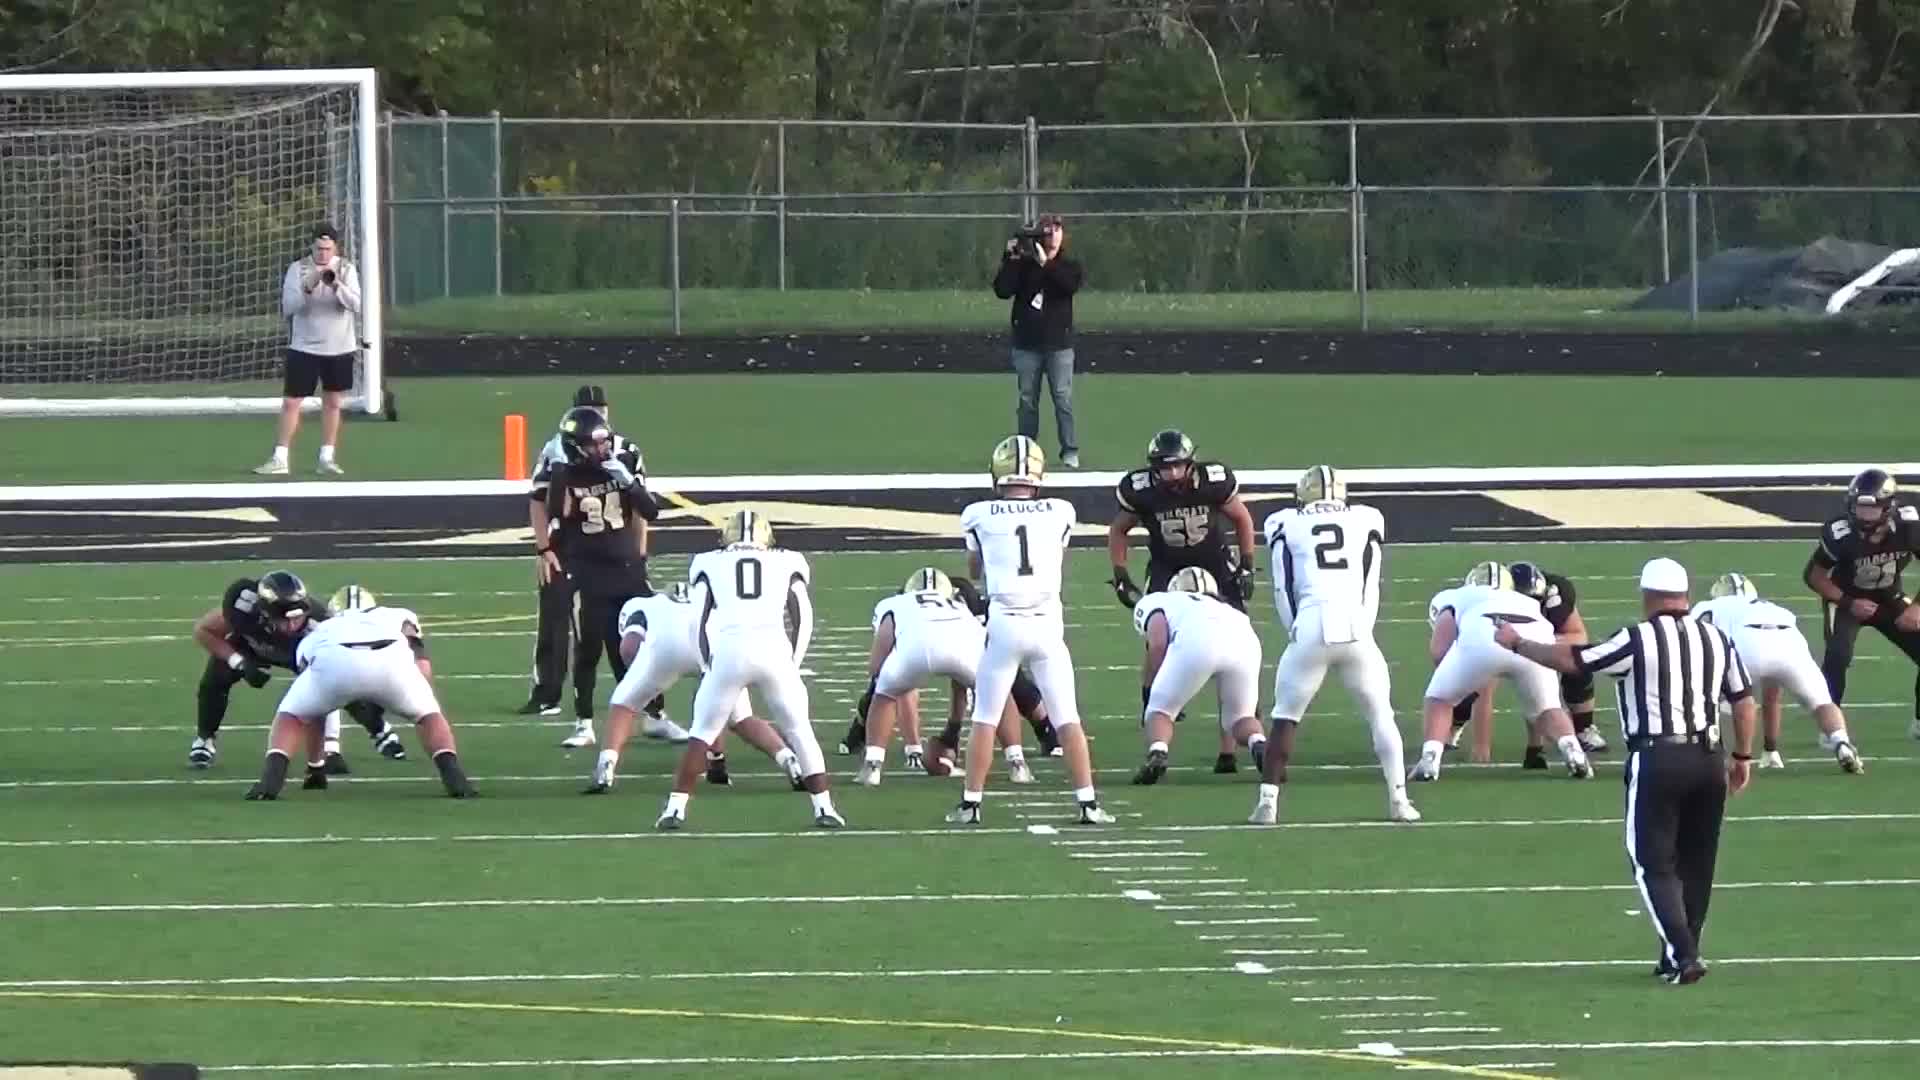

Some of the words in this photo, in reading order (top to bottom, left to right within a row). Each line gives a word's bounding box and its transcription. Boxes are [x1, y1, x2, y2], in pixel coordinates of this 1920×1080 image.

[579, 491, 625, 534] 34
[1160, 516, 1209, 547] 55
[1015, 525, 1033, 576] 1
[1311, 523, 1349, 569] 2
[736, 557, 762, 600] 0
